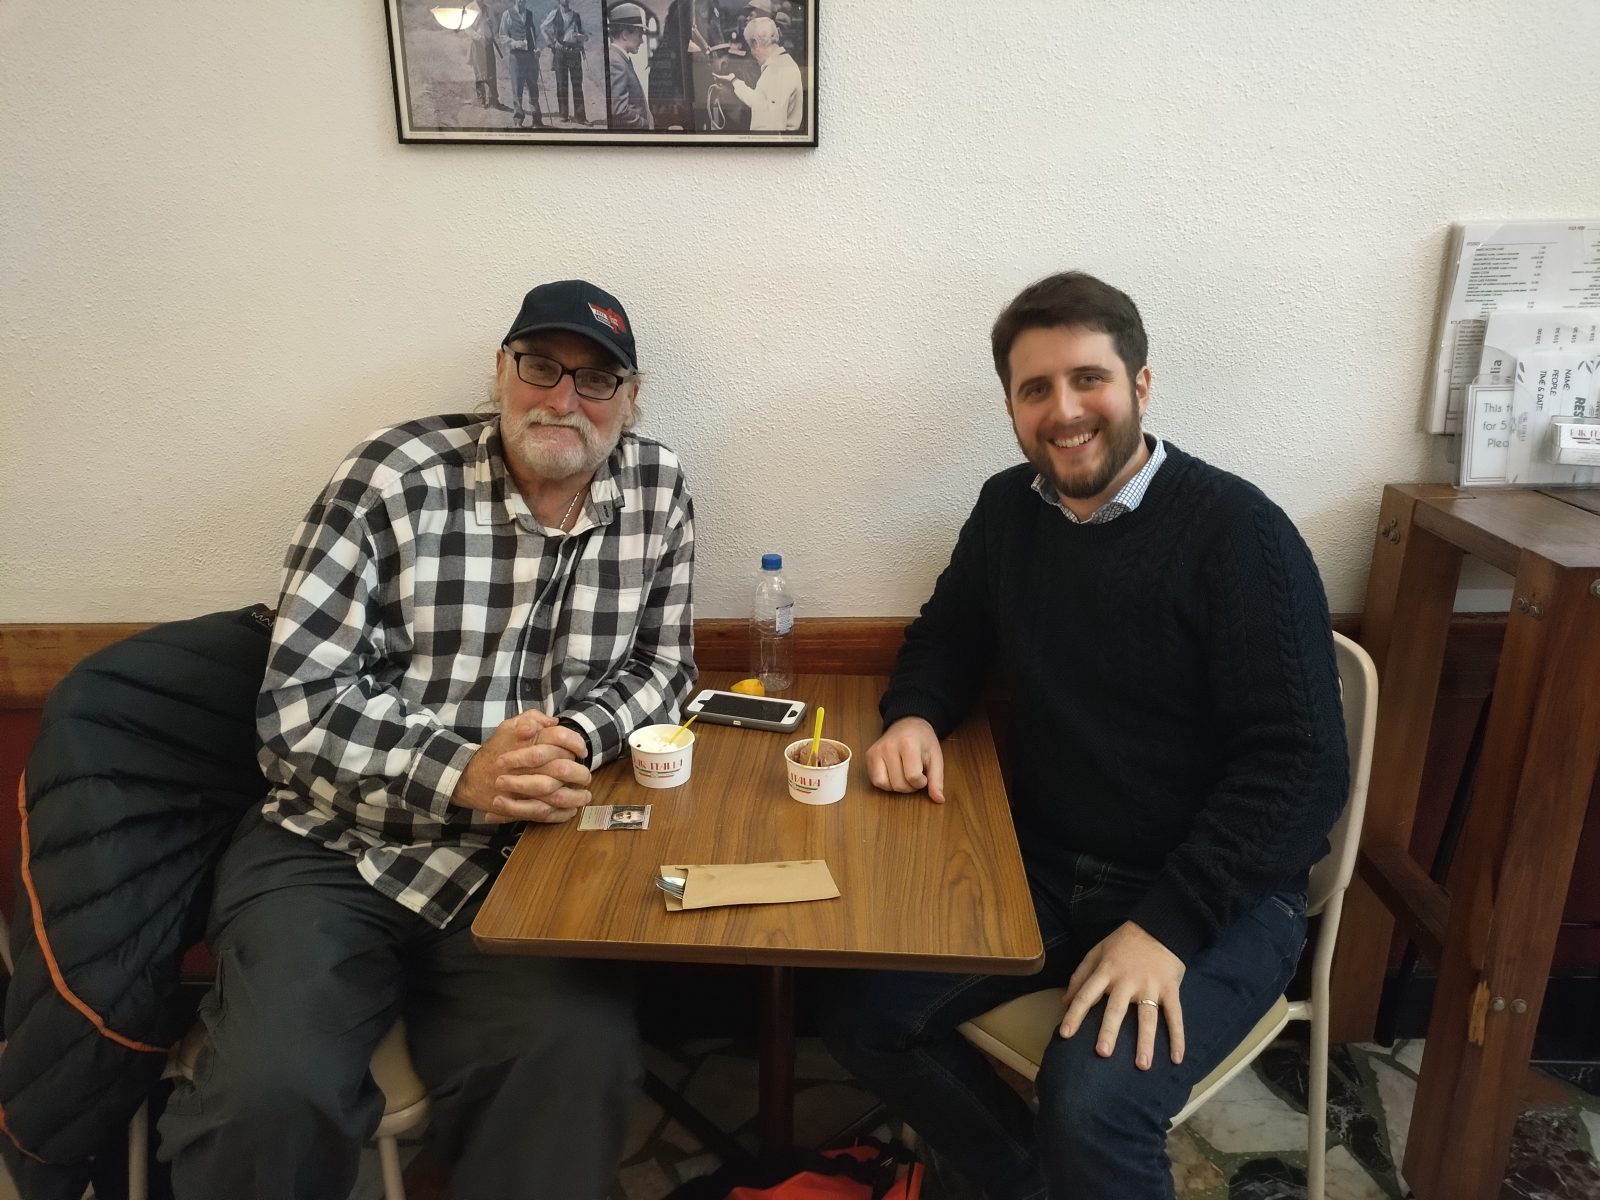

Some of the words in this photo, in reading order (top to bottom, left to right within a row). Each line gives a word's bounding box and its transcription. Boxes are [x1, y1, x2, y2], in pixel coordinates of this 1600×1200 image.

[1538, 370, 1547, 385] TIME
[1483, 402, 1502, 413] This
[1482, 420, 1497, 431] for
[1500, 420, 1508, 431] 5
